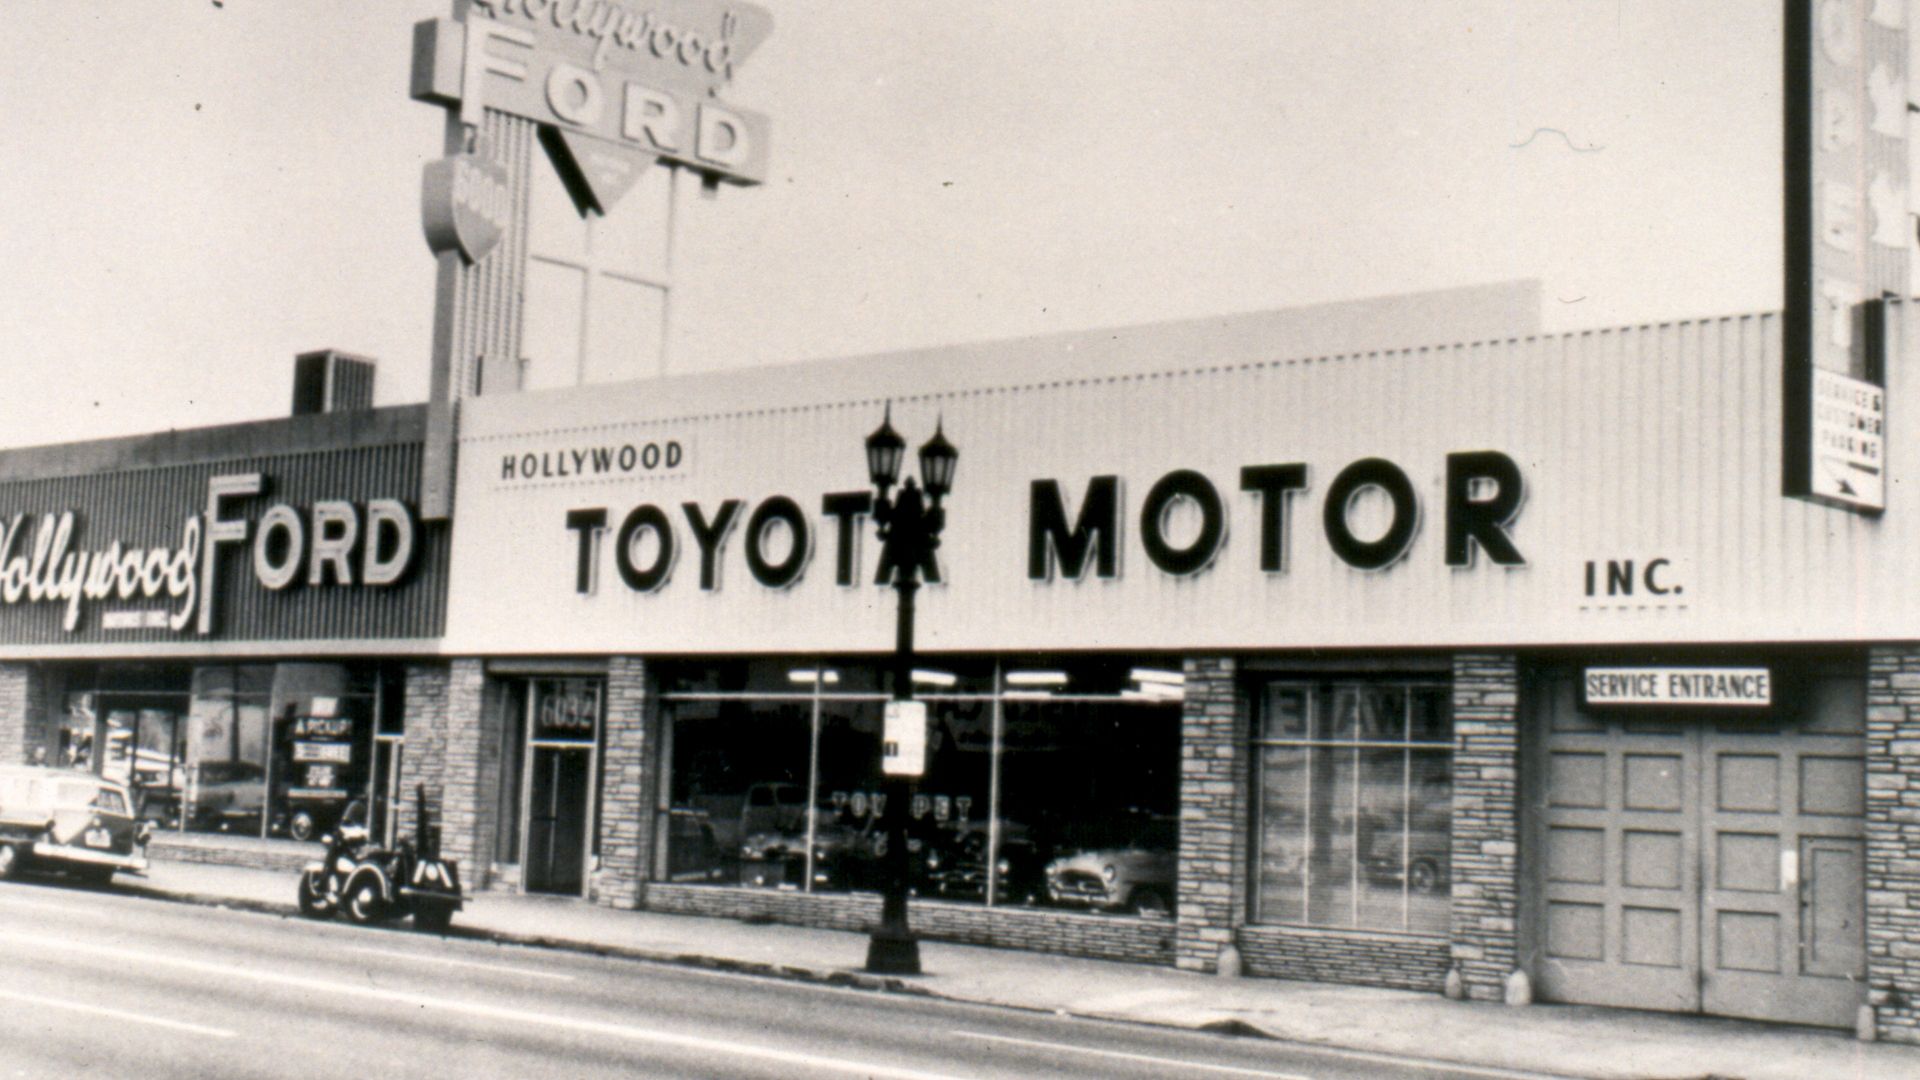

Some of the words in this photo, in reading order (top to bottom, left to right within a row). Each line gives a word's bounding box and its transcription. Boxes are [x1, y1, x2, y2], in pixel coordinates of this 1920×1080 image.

[470, 0, 735, 98] ollywood
[460, 15, 752, 168] FORD
[501, 440, 683, 480] HOLLYWOOD
[1027, 450, 1528, 582] MOTOR
[198, 472, 413, 635] FORD
[1585, 558, 1683, 597] INC.
[1587, 673, 1659, 698] SERVICE
[1668, 674, 1767, 699] ENTRANCE
[831, 790, 972, 822] TOYPET
